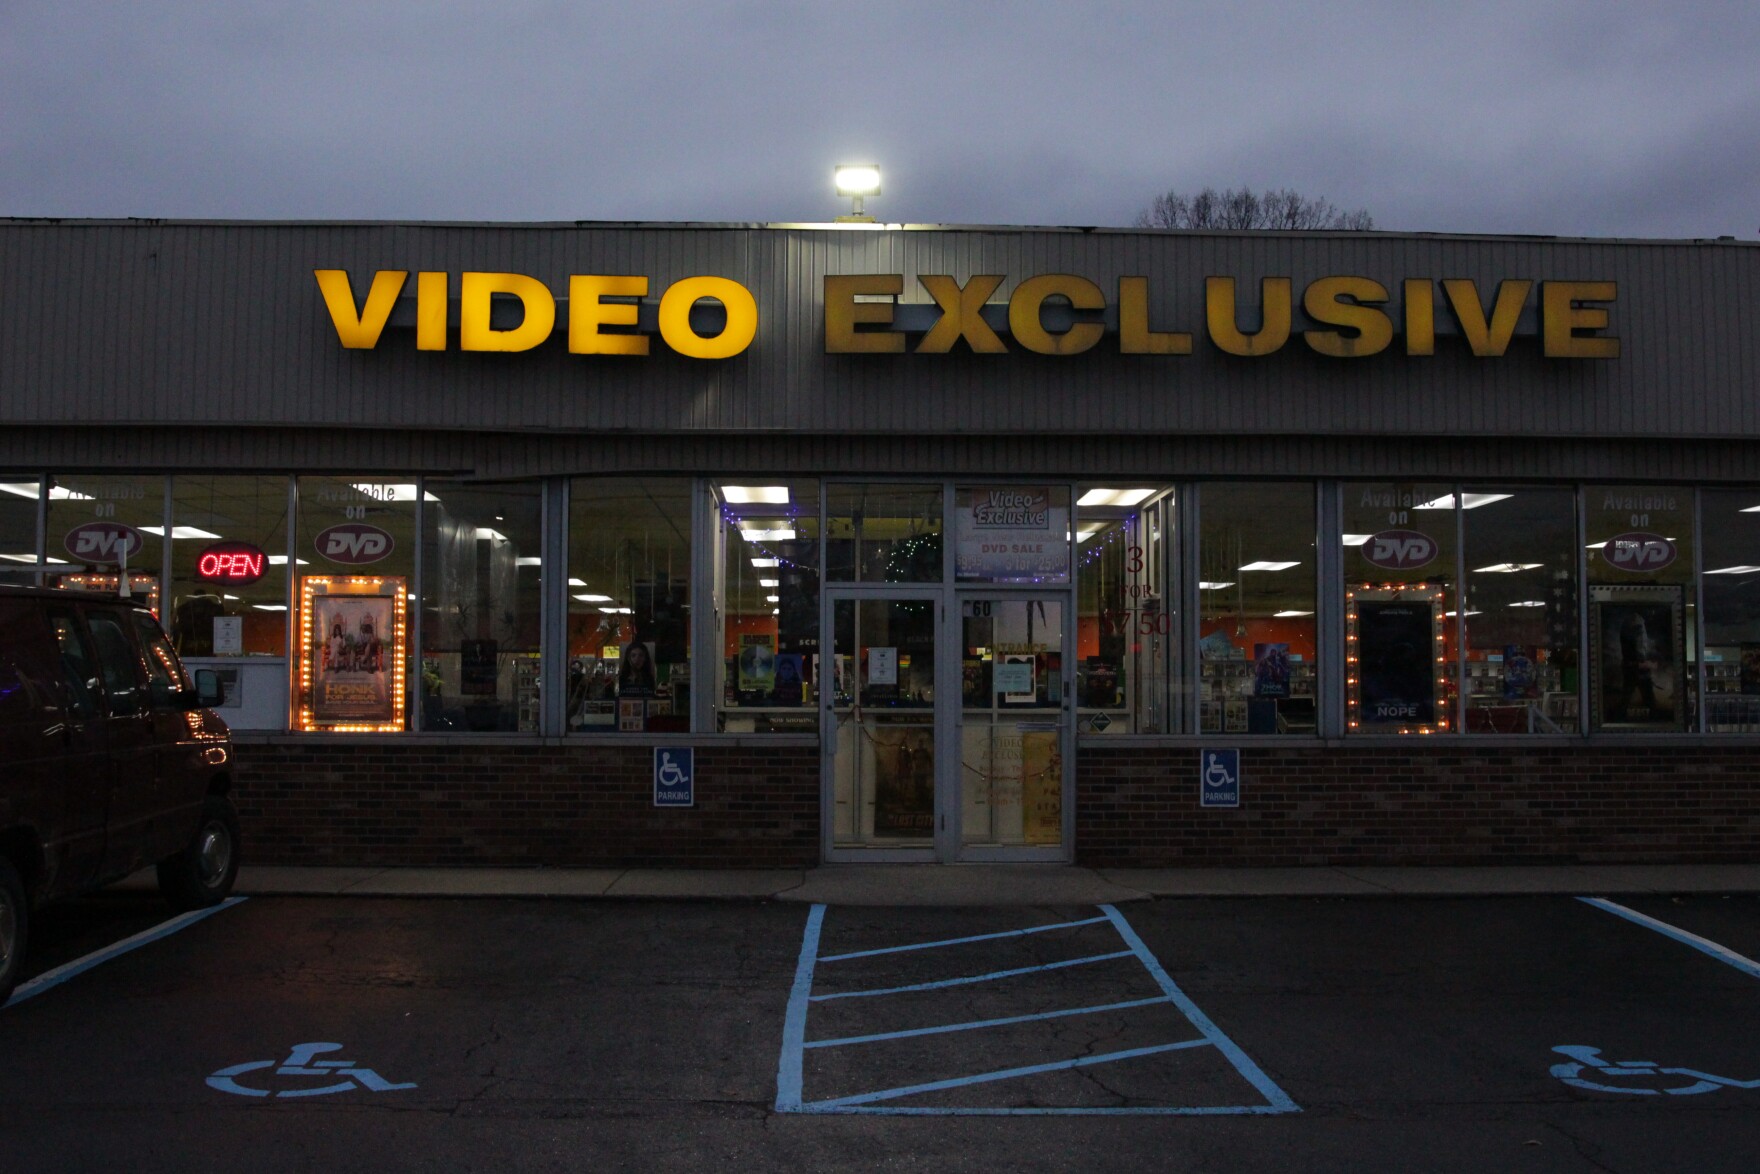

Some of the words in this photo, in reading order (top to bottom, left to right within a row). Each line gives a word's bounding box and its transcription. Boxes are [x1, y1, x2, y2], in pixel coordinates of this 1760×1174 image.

[314, 269, 758, 359] VIDEO
[824, 273, 1621, 358] EXCLUSIVE
[317, 484, 395, 501] Available
[988, 488, 1034, 507] Video
[1360, 487, 1436, 508] Available
[1602, 491, 1677, 511] Available
[95, 502, 115, 517] on
[345, 504, 366, 520] on
[976, 508, 1045, 525] Exclusive
[1388, 510, 1408, 525] on
[1630, 513, 1649, 528] on
[326, 532, 387, 558] DVD
[982, 543, 1008, 554] DVD
[1012, 543, 1044, 554] SALE
[1372, 539, 1431, 566] DVD
[1613, 540, 1670, 566] DVD
[199, 553, 263, 577] OPEN
[1127, 546, 1143, 573] 3
[1120, 584, 1152, 599] FOR
[984, 643, 1048, 655] ENTRANCE
[325, 683, 376, 695] HONK
[1377, 706, 1417, 717] NOPE
[657, 791, 690, 800] PARKING
[1205, 792, 1236, 801] PARKING
